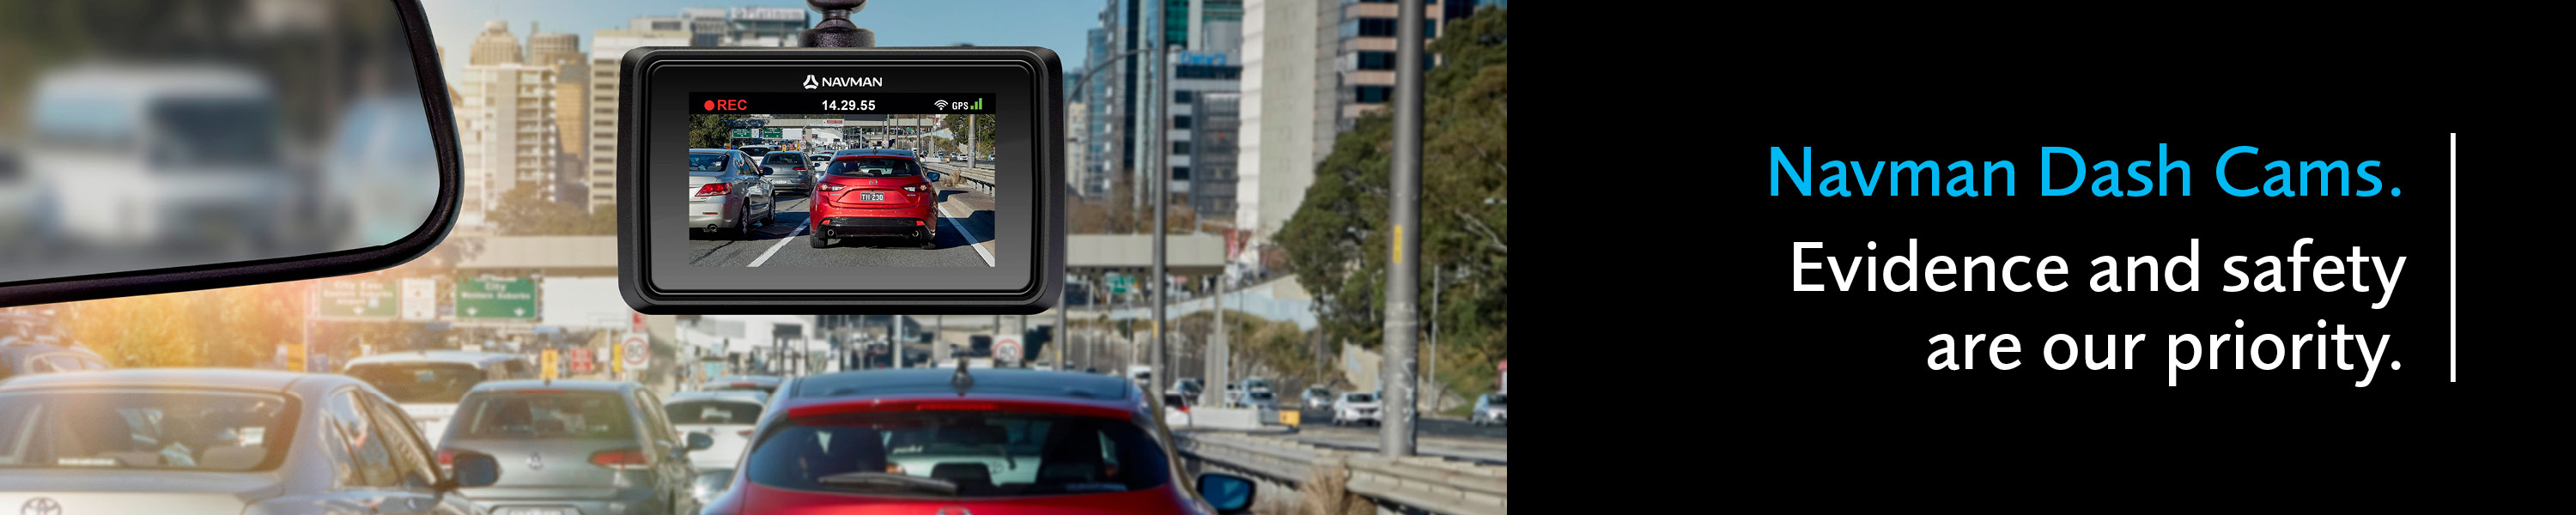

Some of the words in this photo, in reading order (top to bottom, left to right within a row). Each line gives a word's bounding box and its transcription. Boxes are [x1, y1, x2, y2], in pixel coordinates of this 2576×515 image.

[822, 76, 883, 88] NAVMAN
[717, 99, 748, 111] REC
[822, 100, 876, 111] 14.29.55
[951, 101, 969, 111] GPS
